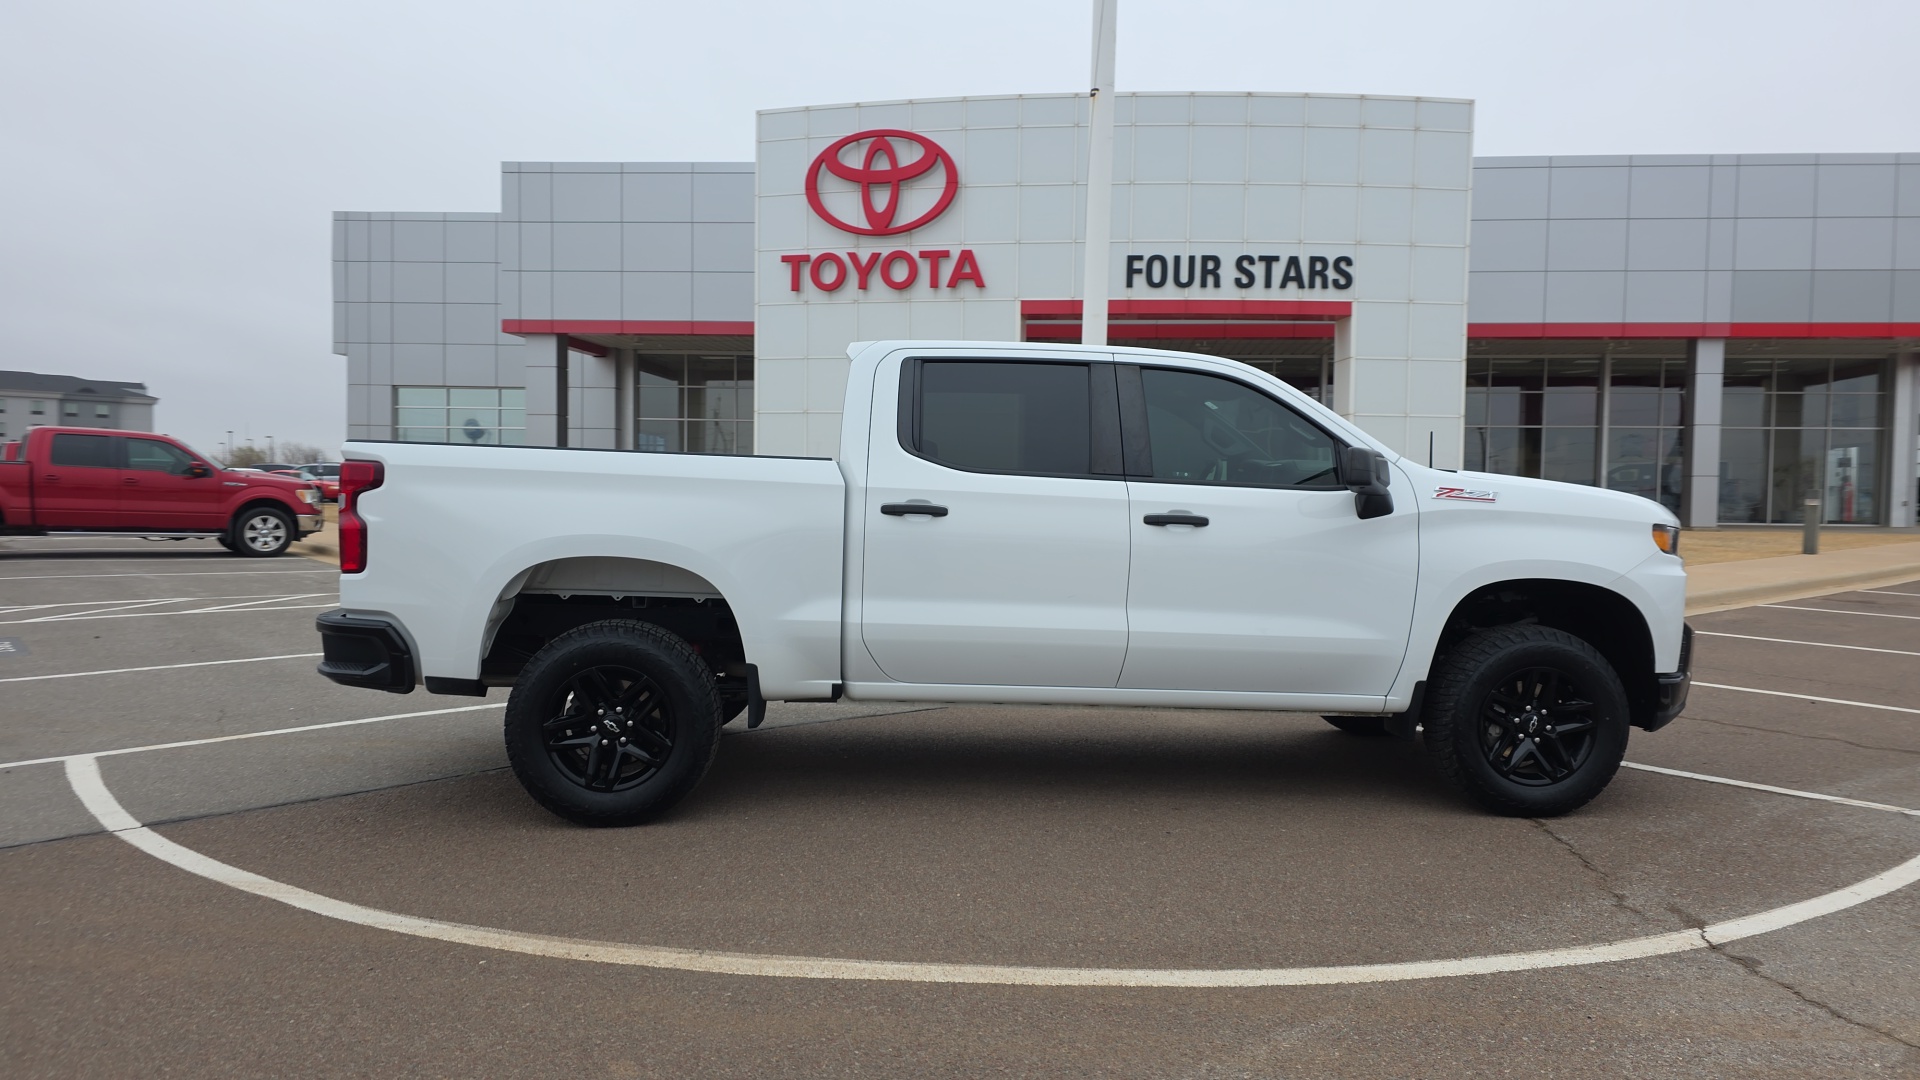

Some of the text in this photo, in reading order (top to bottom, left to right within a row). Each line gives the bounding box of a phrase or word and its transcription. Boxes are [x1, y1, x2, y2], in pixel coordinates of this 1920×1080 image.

[781, 249, 986, 292] TOYOTA
[1126, 254, 1354, 290] FOUR STARS
